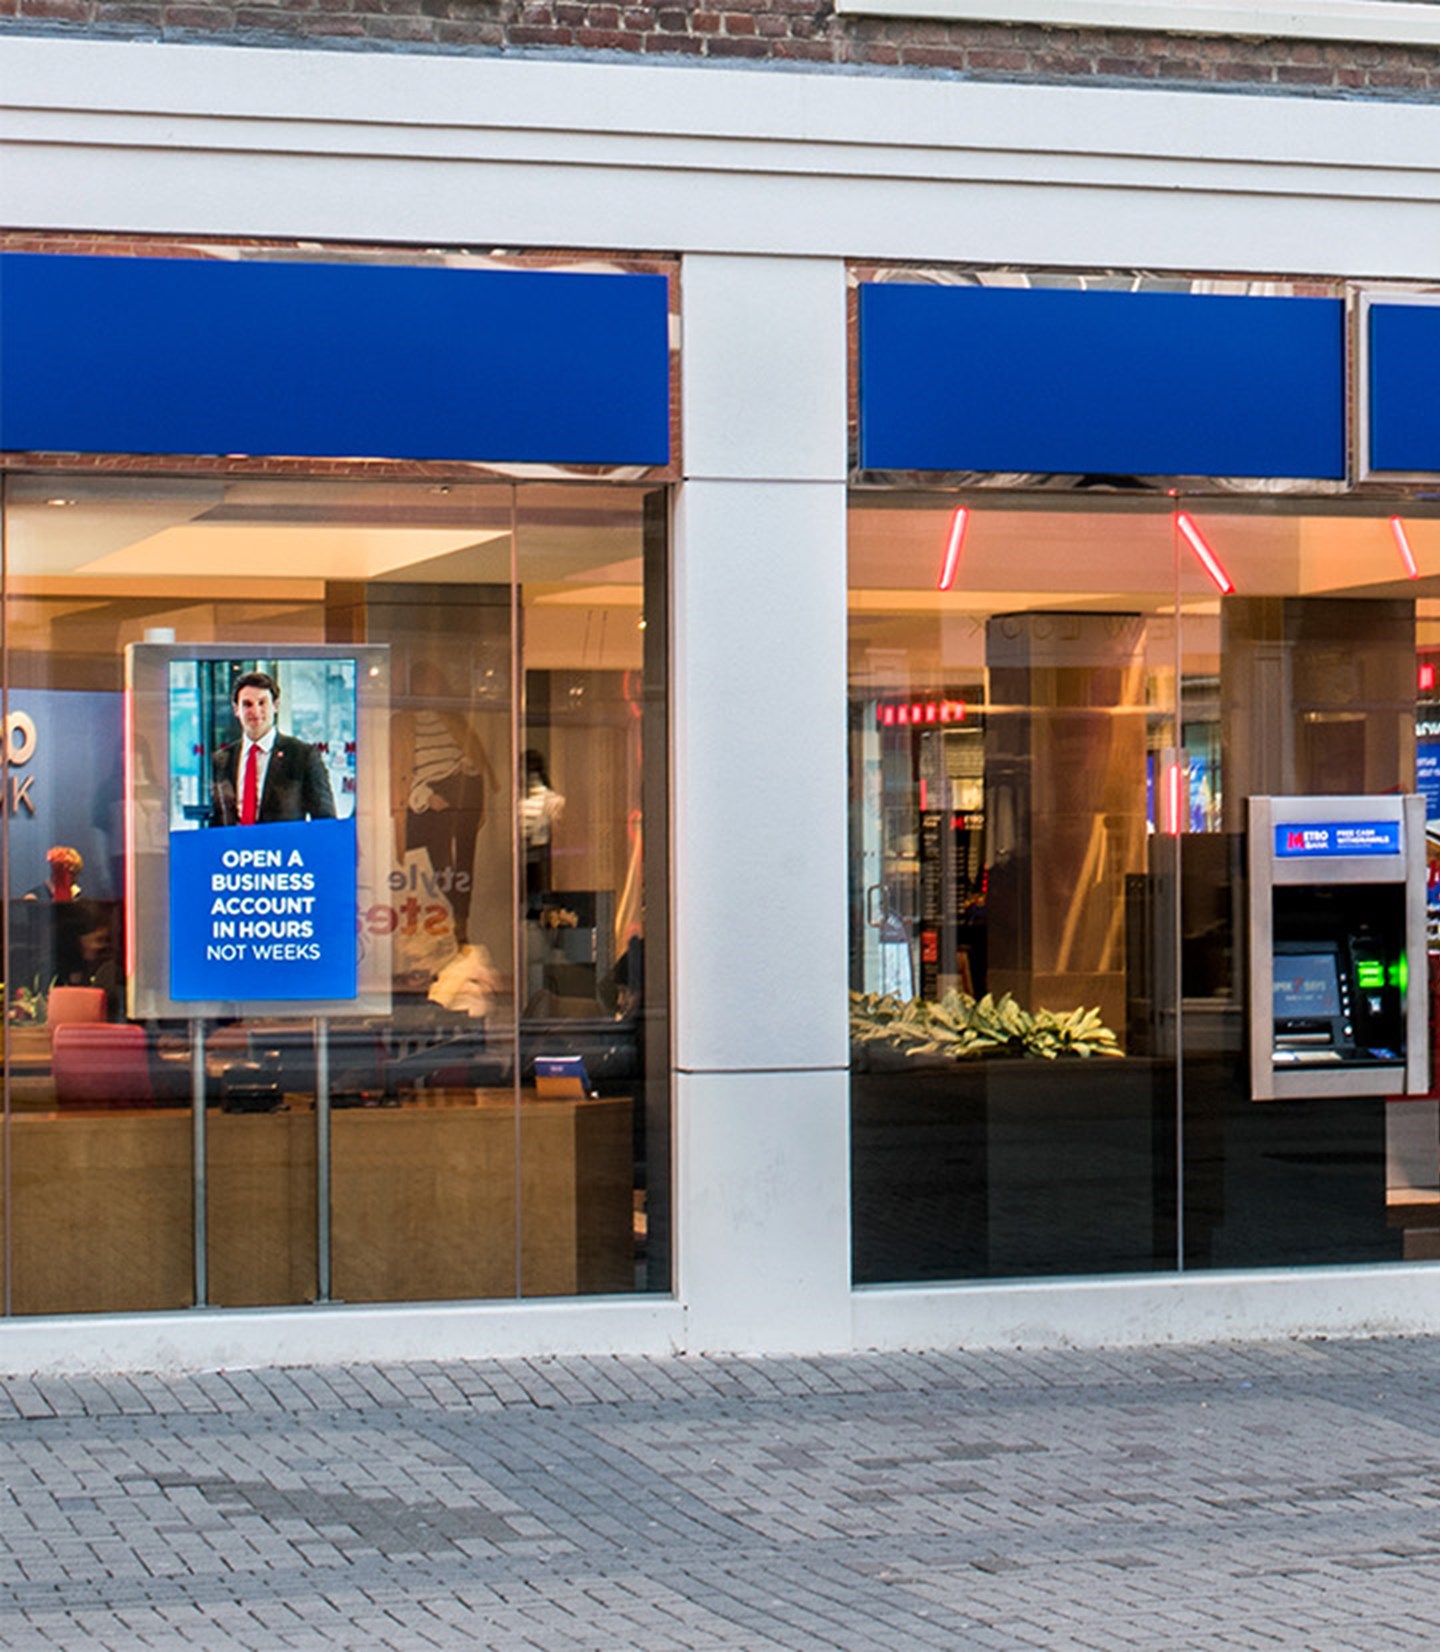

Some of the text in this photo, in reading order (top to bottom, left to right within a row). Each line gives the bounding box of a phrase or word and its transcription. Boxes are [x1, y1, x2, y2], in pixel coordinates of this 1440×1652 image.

[0, 711, 36, 764] O
[222, 849, 304, 868] OPEN A
[211, 873, 315, 892] BUSINESS
[211, 897, 316, 915] ACCOUNT
[213, 920, 314, 938] IN HOURS
[207, 943, 321, 961] NOT WEEKS
